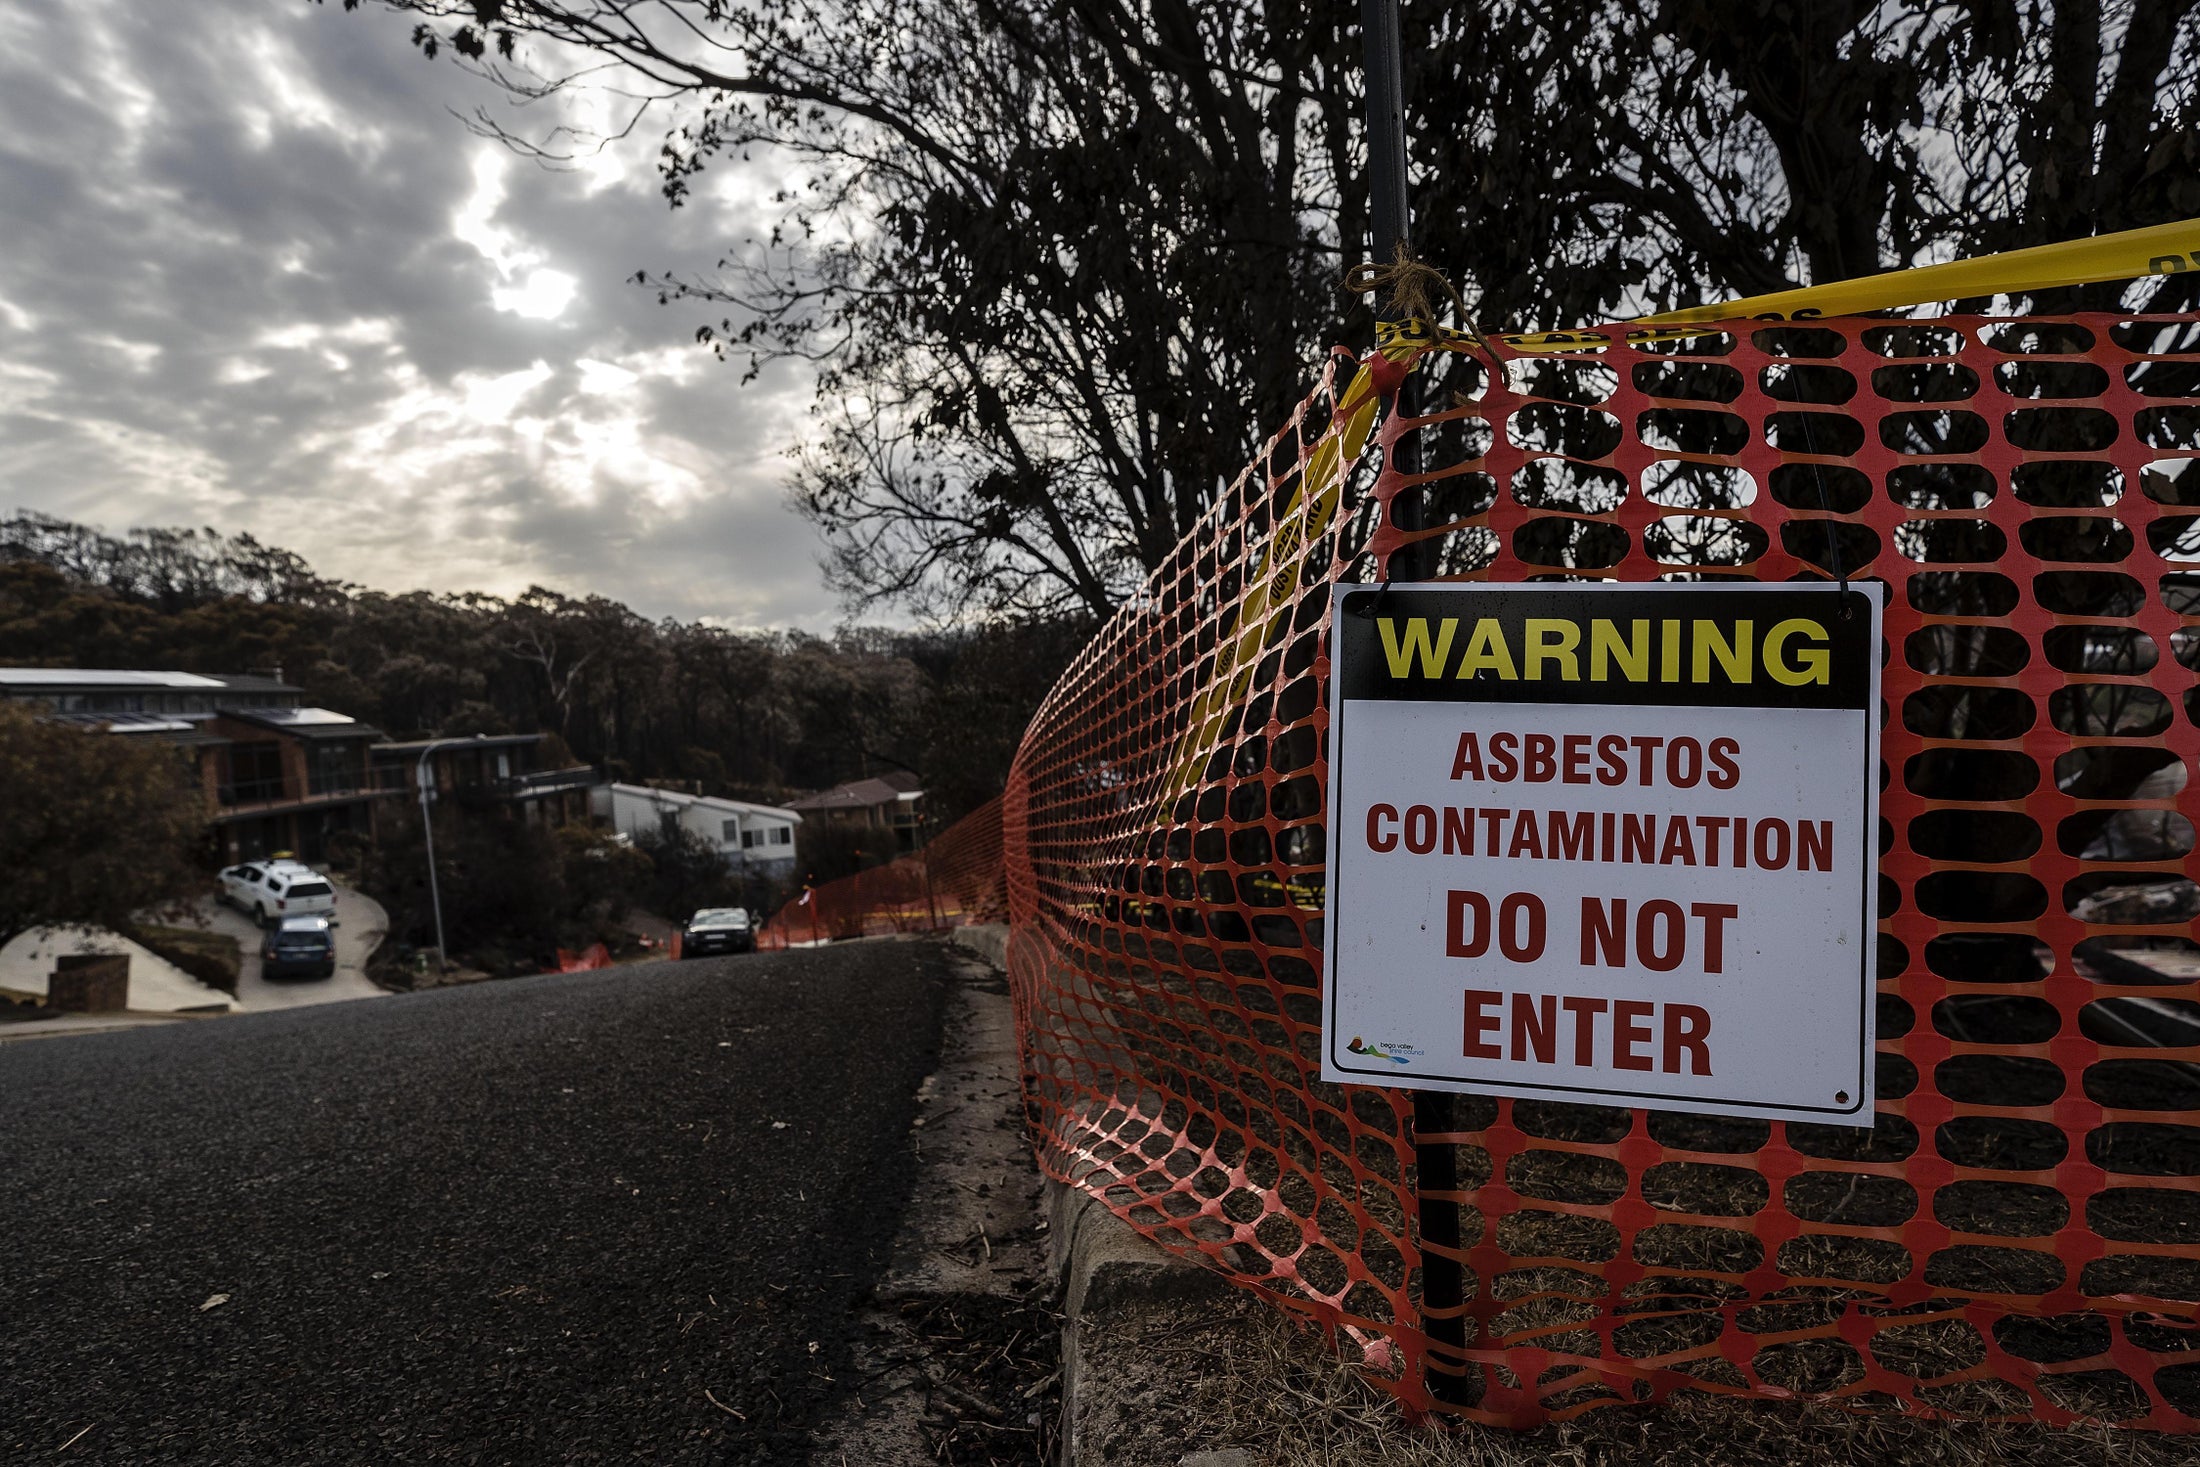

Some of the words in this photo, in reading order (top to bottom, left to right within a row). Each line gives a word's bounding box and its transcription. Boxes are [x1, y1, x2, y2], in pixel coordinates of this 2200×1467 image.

[1376, 617, 1830, 686] WARNING
[1450, 732, 1740, 790] ASBESTOS
[1366, 803, 1833, 872] CONTAMINATION
[1446, 889, 1547, 963] DO
[1580, 896, 1738, 974] NOT
[1463, 989, 1713, 1077] ENTER
